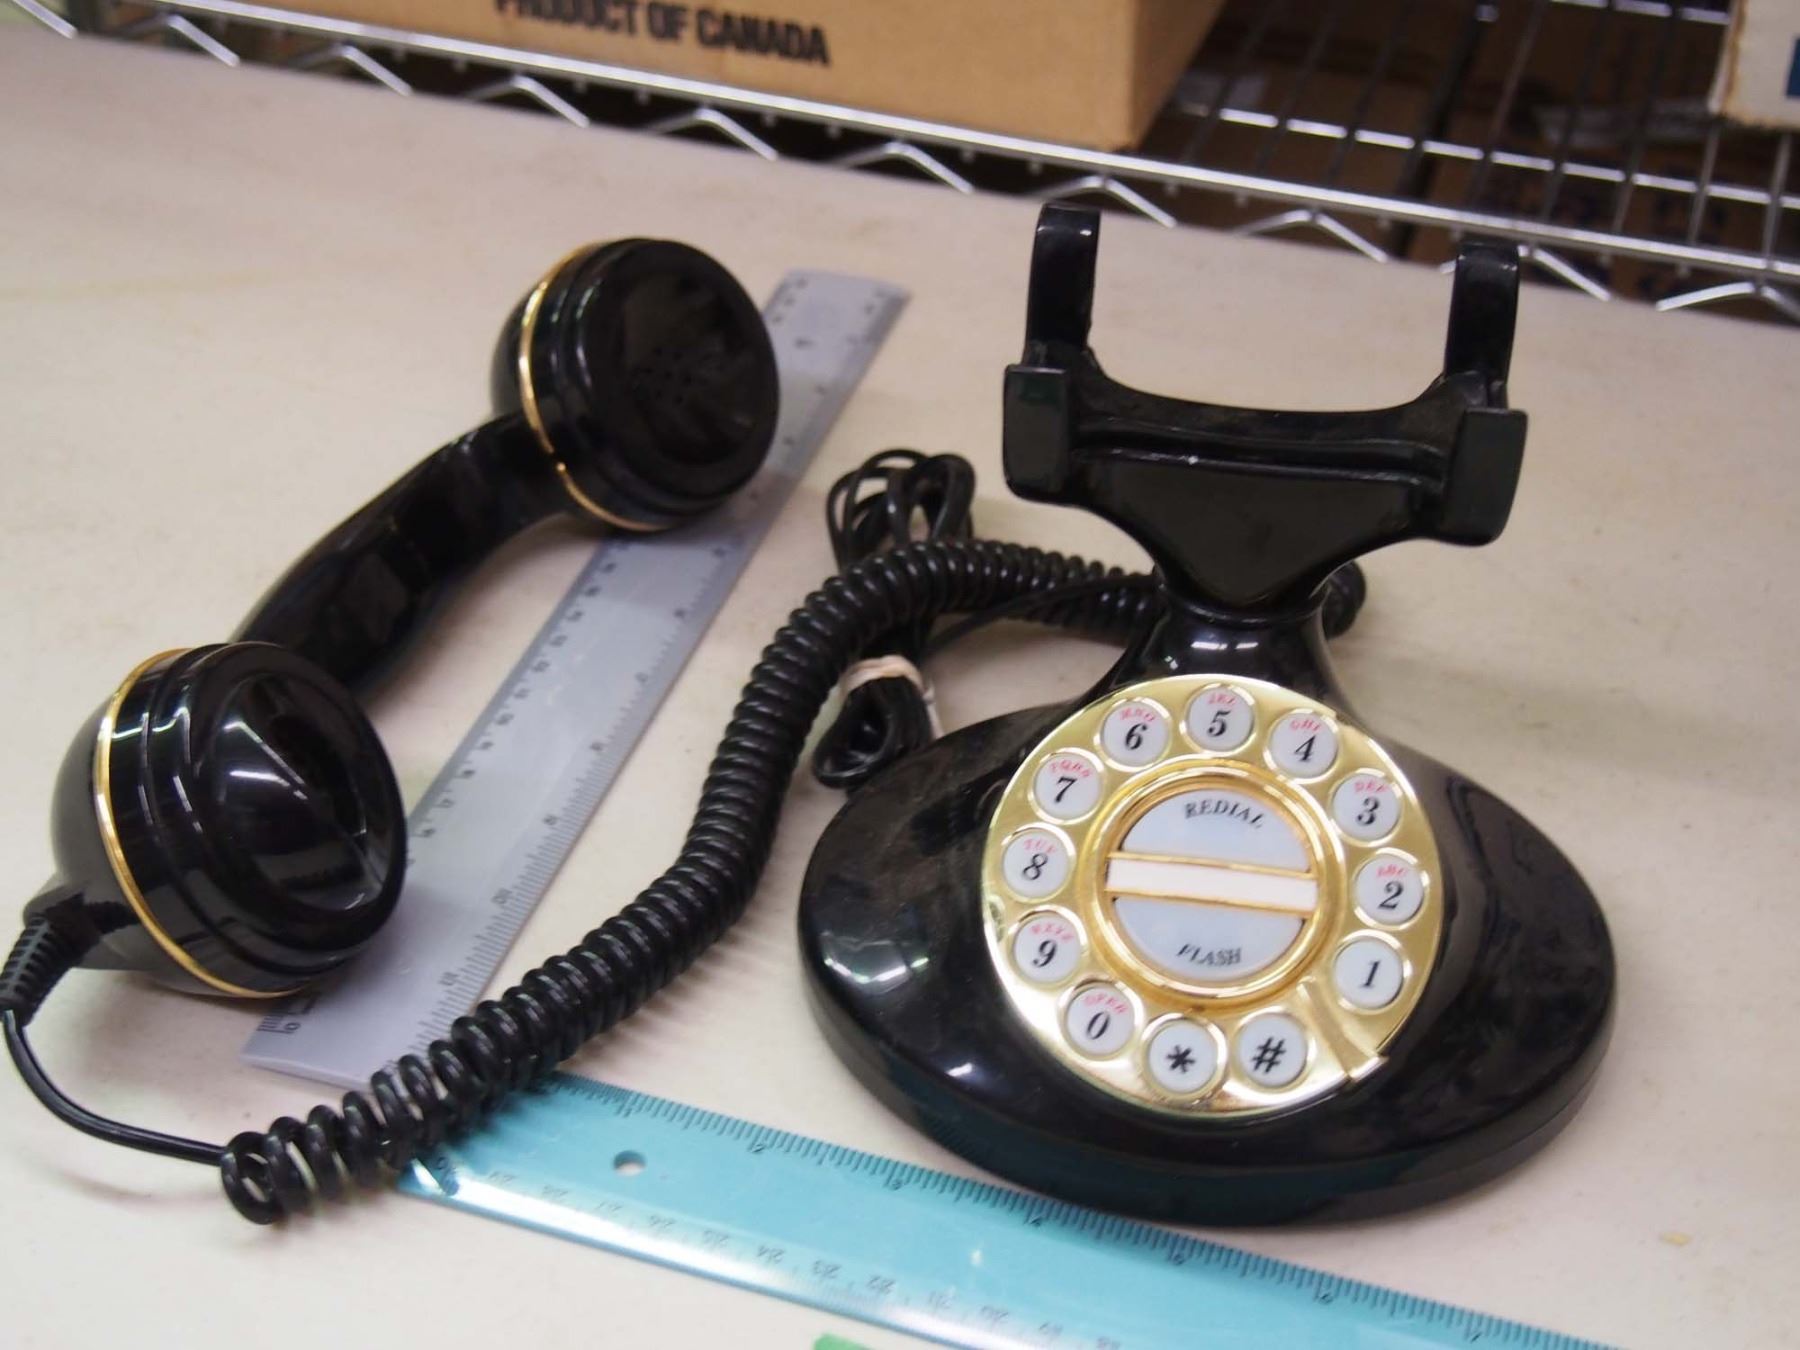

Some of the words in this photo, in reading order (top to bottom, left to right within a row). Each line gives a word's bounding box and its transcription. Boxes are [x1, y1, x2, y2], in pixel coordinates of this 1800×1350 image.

[647, 1, 690, 42] OF
[696, 8, 834, 67] CANADA
[1125, 722, 1148, 751] 6
[1207, 709, 1231, 738] 5
[1294, 735, 1316, 763] 4
[1054, 776, 1078, 804] 7
[1185, 799, 1265, 829] REDIAL
[1357, 796, 1380, 826] 3
[1022, 852, 1048, 881] 8
[1377, 880, 1404, 911] 2
[1032, 939, 1058, 969] 9
[1176, 943, 1242, 967] FLASH
[1359, 960, 1381, 990] 1
[1085, 1011, 1111, 1041] 0
[1251, 1037, 1287, 1074] #
